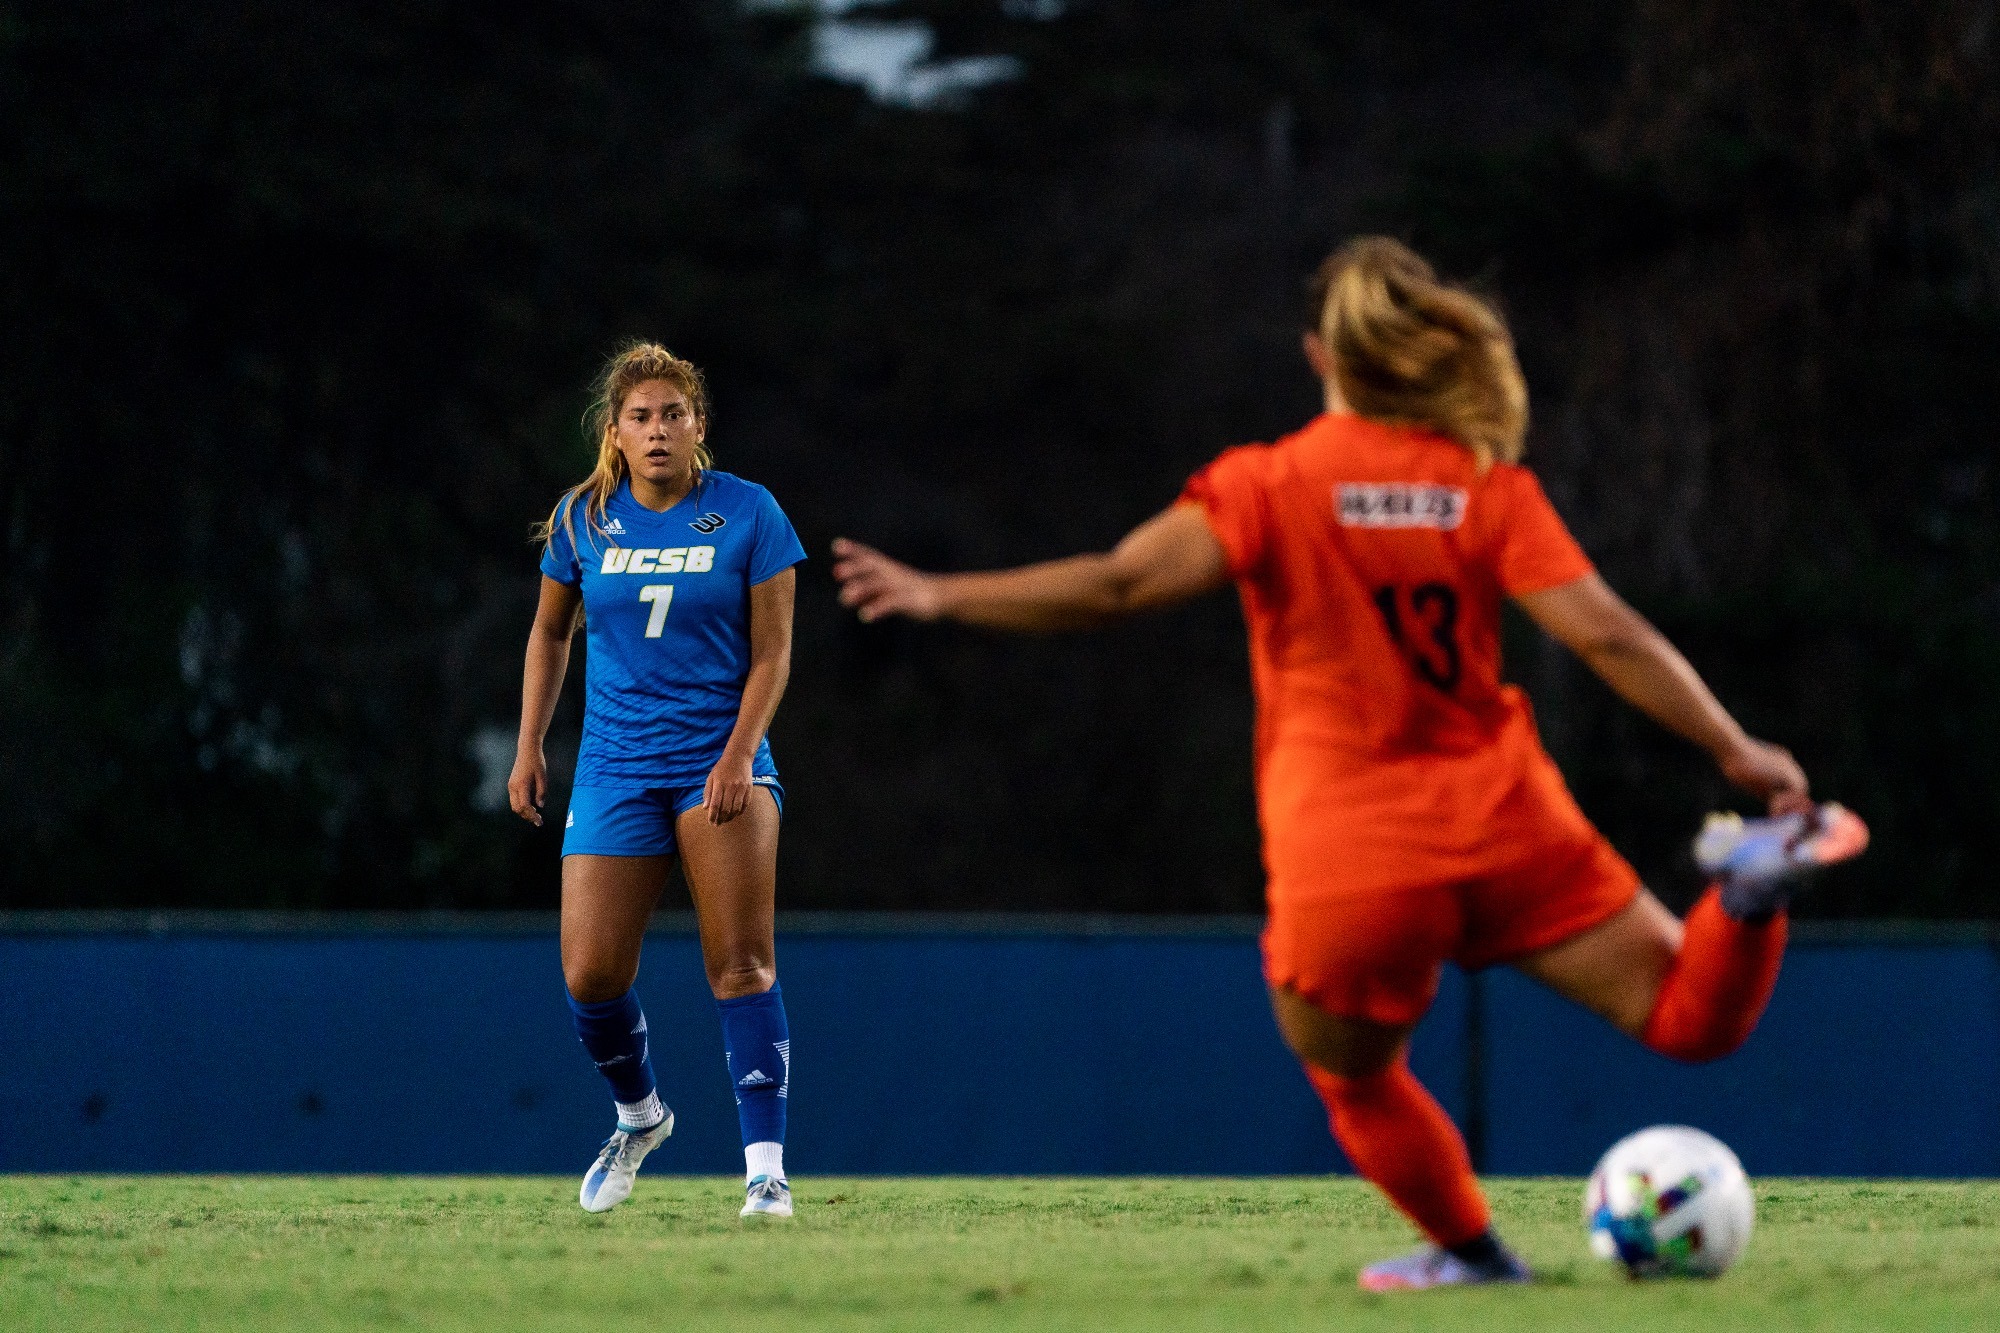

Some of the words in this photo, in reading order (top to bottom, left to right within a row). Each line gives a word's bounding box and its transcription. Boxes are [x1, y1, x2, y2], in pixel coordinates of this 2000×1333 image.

[600, 546, 716, 574] UCSB
[639, 584, 674, 638] 7
[1373, 581, 1461, 693] 13
